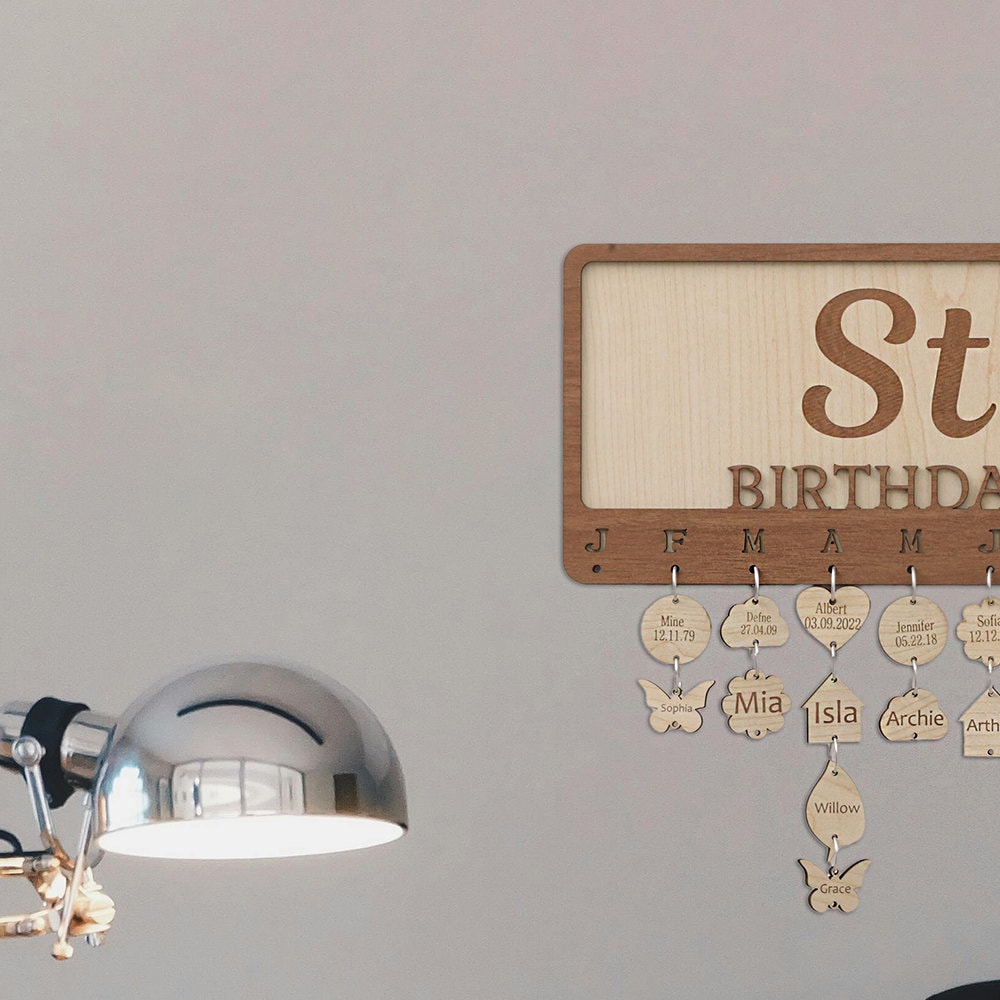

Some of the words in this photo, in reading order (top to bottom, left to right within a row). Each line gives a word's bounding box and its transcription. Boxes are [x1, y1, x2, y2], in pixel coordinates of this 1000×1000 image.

[585, 528, 609, 554] J
[663, 528, 688, 554] F
[741, 528, 766, 554] M
[820, 528, 844, 554] A
[899, 528, 924, 554] M
[815, 602, 847, 614] Albert
[660, 616, 684, 628] Mine
[746, 612, 772, 622] Defne
[804, 617, 861, 630] 03.09.2022
[896, 620, 935, 633] Jennifer
[654, 630, 696, 642] 12.11.79
[740, 625, 778, 636] 27.04.09
[896, 634, 938, 647] 05.22.18
[734, 690, 783, 714] Mia
[660, 704, 693, 715] Sophia
[815, 700, 858, 724] Isla
[886, 710, 944, 726] Archie
[814, 802, 860, 814] Willow
[820, 884, 851, 894] Grace
